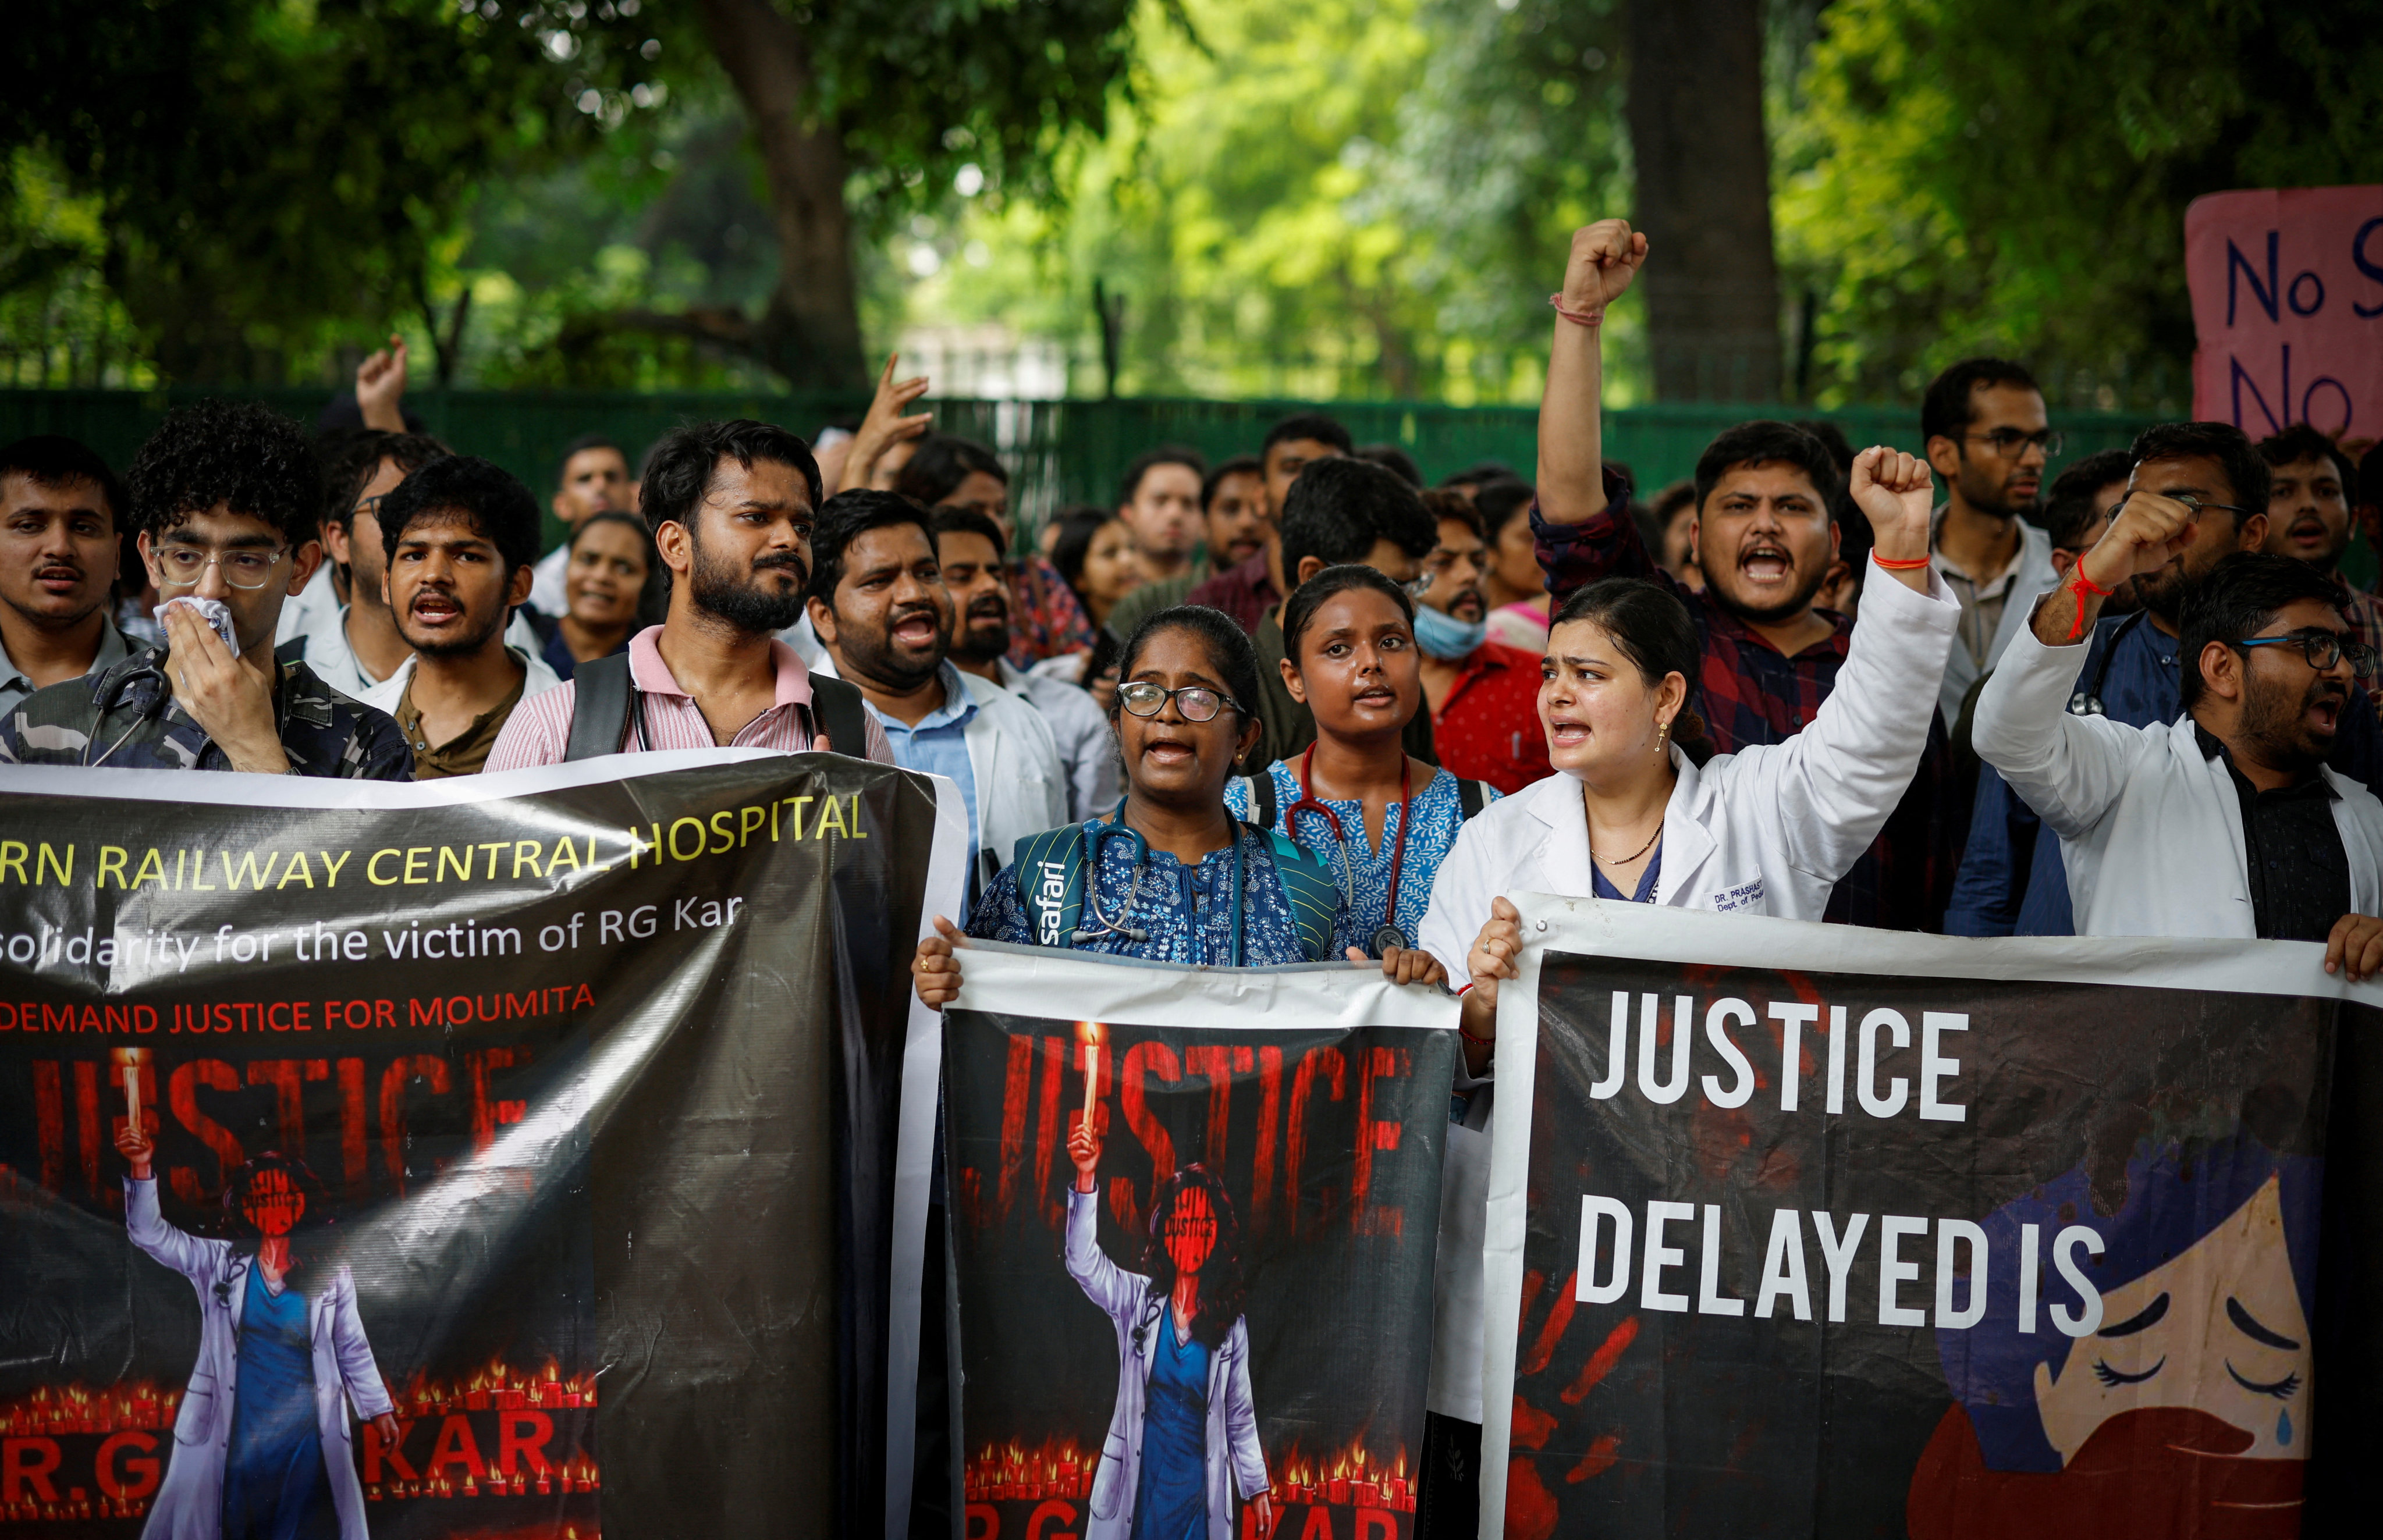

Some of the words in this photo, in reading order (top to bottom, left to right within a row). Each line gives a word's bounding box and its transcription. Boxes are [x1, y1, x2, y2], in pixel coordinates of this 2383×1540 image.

[2227, 230, 2325, 328] No
[2231, 342, 2352, 435] No
[0, 841, 74, 887] RN
[97, 845, 351, 890] RAILWAY
[367, 835, 610, 885] CENTRAL
[630, 795, 867, 869] HOSPITAL
[0, 924, 200, 972] olidarity
[214, 924, 281, 963] for
[295, 921, 368, 961] the
[383, 919, 521, 960] victim
[539, 911, 586, 952] of
[600, 905, 657, 945] RG
[674, 896, 744, 931] Kar
[1035, 860, 1066, 945] safari
[1714, 894, 1728, 904] DR.
[1741, 896, 1748, 905] of
[168, 1001, 310, 1034] JUSTICE
[325, 999, 397, 1030] FOR
[409, 983, 595, 1027] MOUMITA
[1589, 990, 1969, 1122] JUSTICE
[1574, 1194, 1988, 1329] DELAYED
[2018, 1223, 2105, 1338] IS
[2, 1431, 161, 1502] R.G
[363, 1410, 554, 1483] KAR
